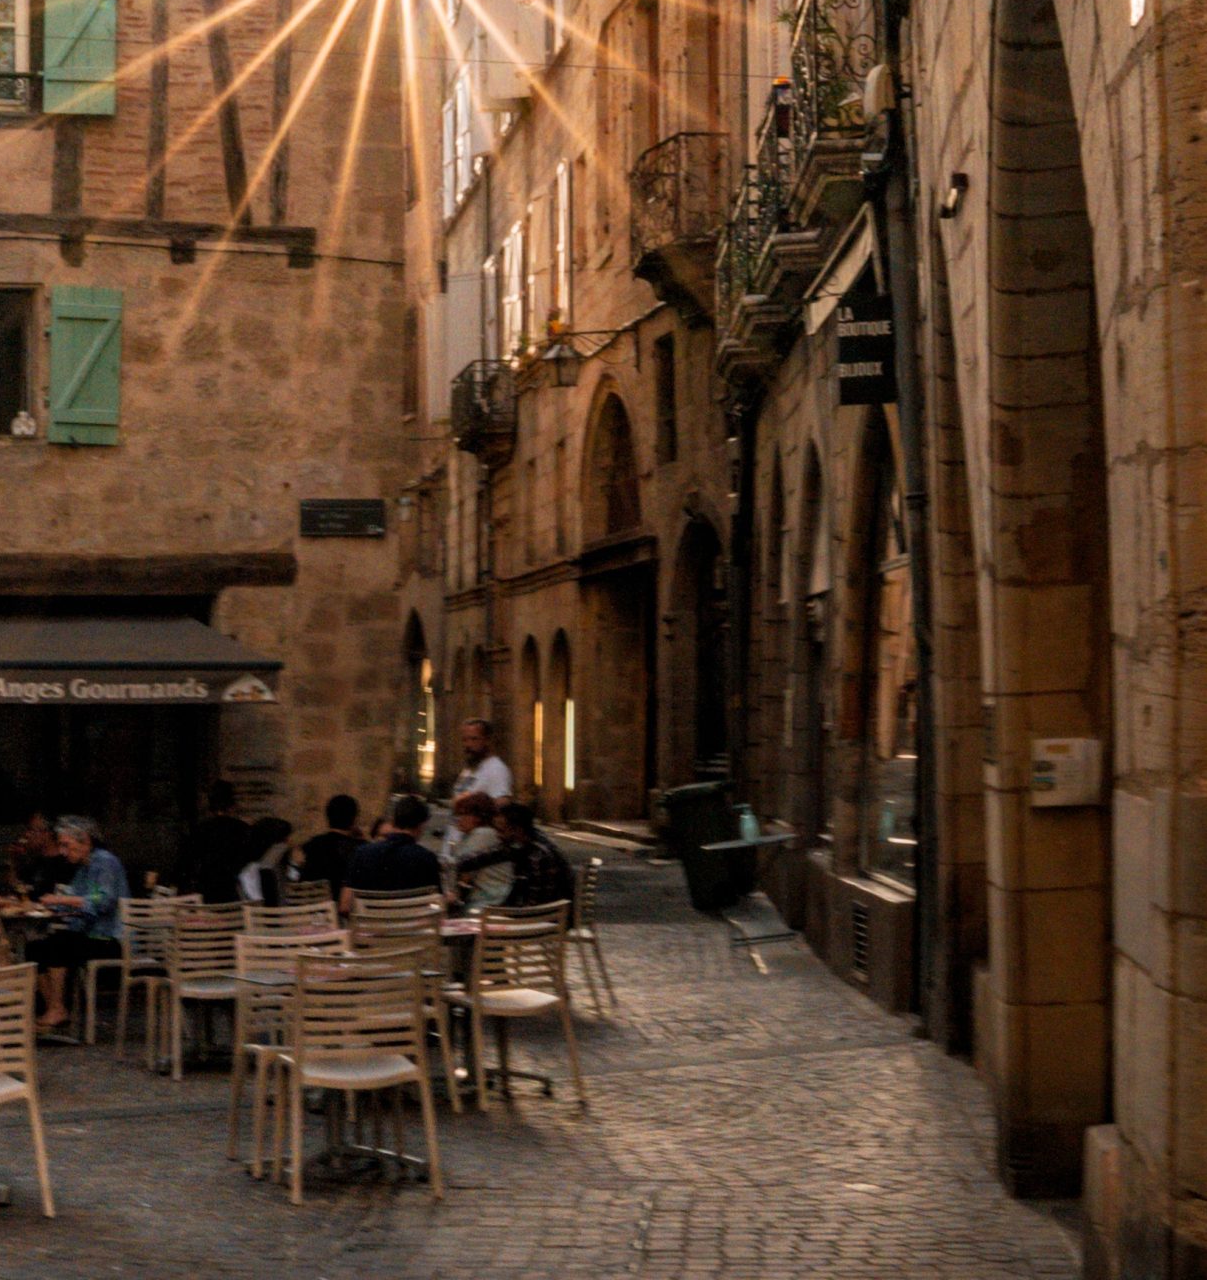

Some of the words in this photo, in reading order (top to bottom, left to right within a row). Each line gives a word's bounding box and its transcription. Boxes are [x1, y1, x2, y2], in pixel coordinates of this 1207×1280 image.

[837, 307, 854, 321] LA
[837, 321, 892, 337] BOUTIQUE
[838, 362, 884, 377] BIJOUX
[69, 677, 209, 699] Gourmands
